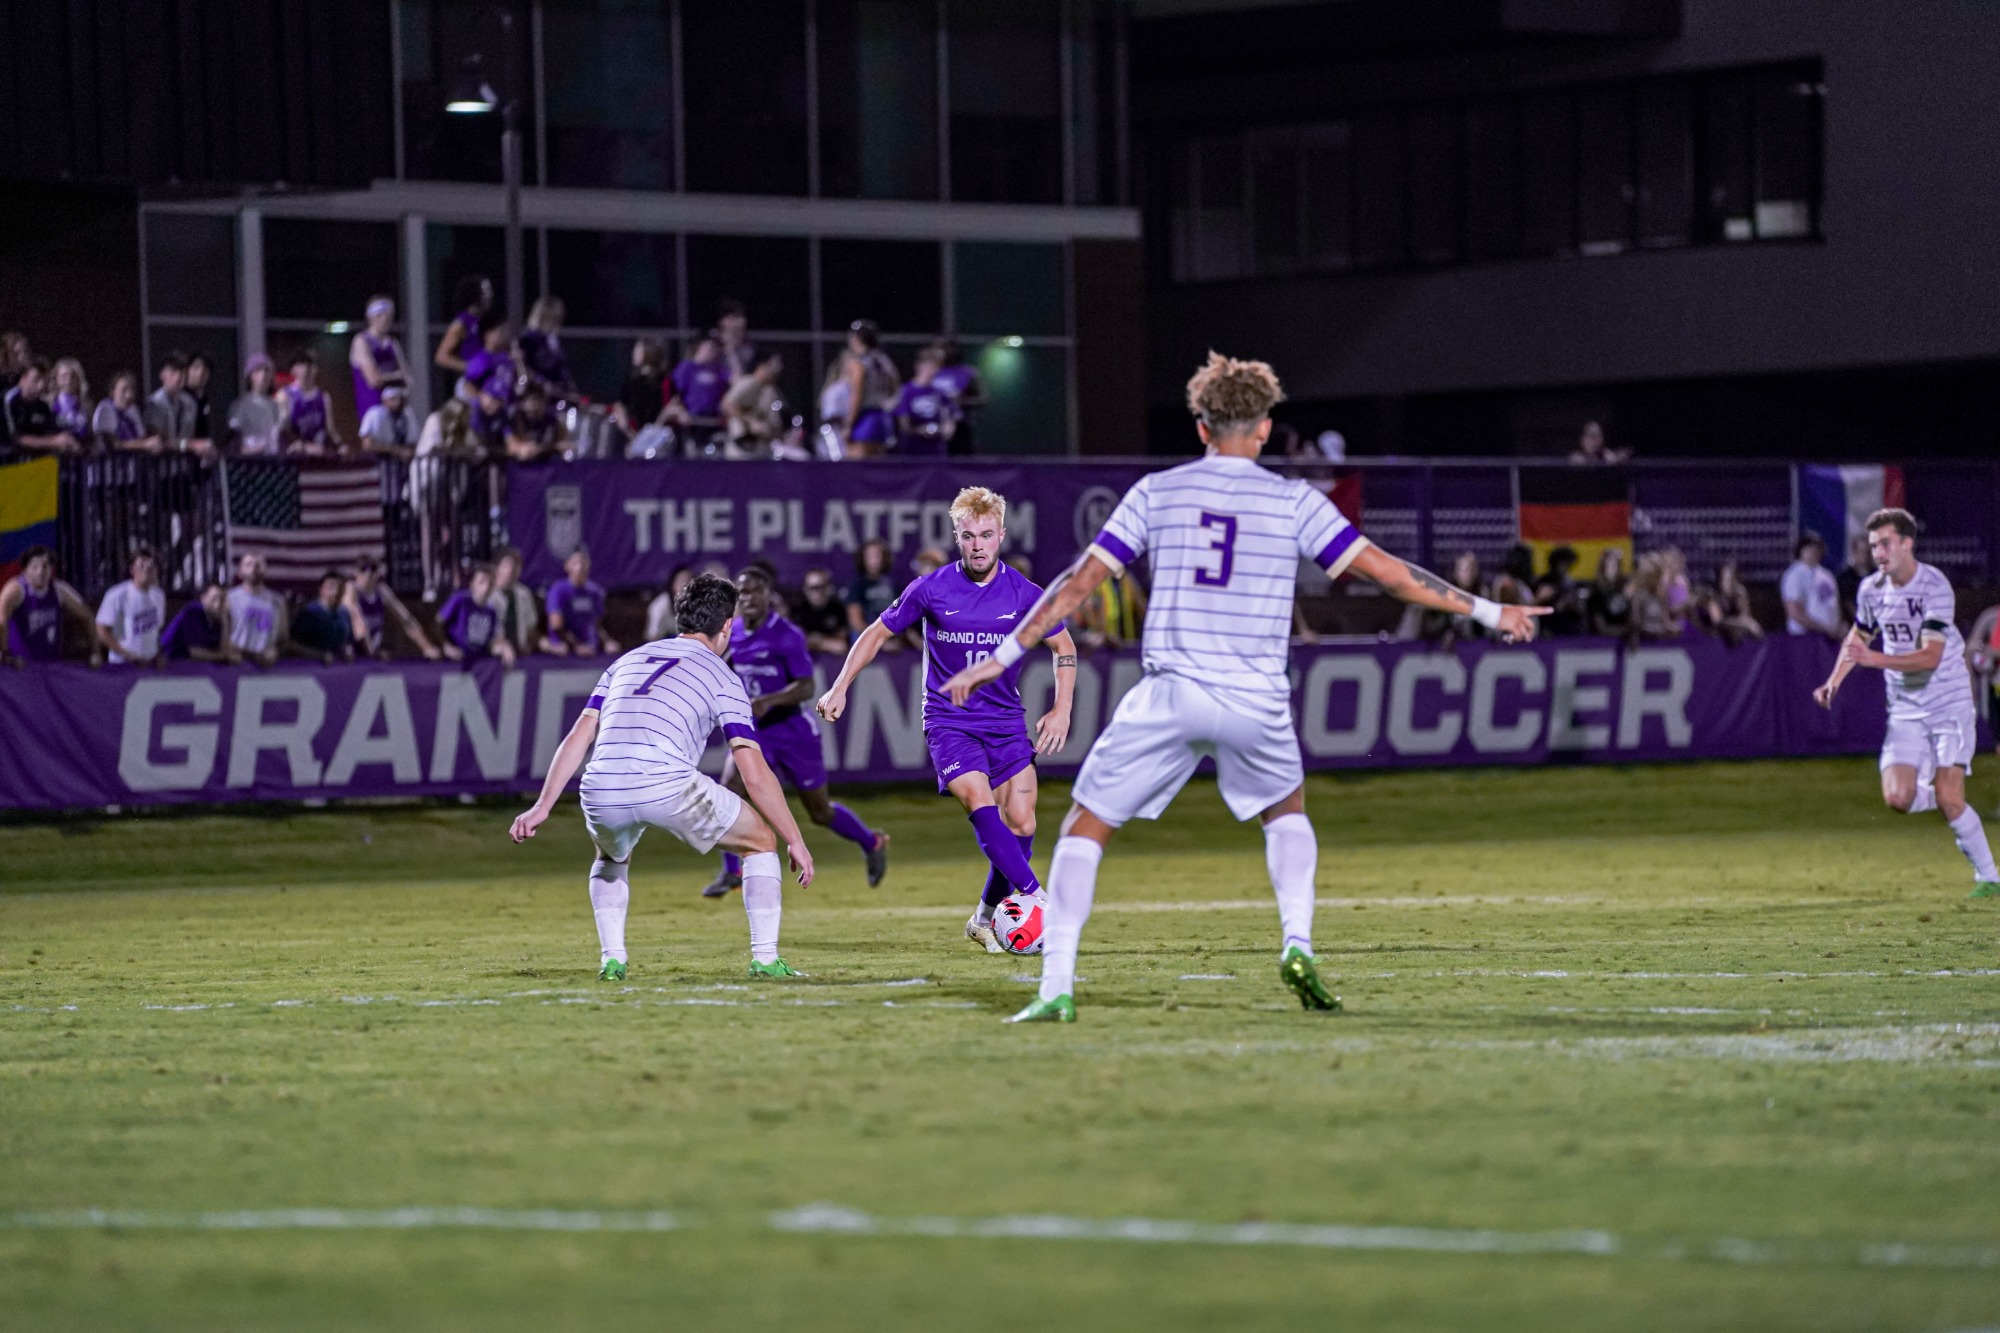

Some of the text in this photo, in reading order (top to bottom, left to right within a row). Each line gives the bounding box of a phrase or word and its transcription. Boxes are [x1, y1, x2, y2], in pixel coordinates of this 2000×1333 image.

[624, 499, 734, 552] THE
[748, 499, 1035, 552] PLATFOM
[1195, 510, 1237, 588] 3
[937, 630, 1009, 645] GRAND CANY
[632, 656, 681, 696] 7
[1290, 648, 1694, 757] OCCER
[942, 761, 961, 776] WAC
